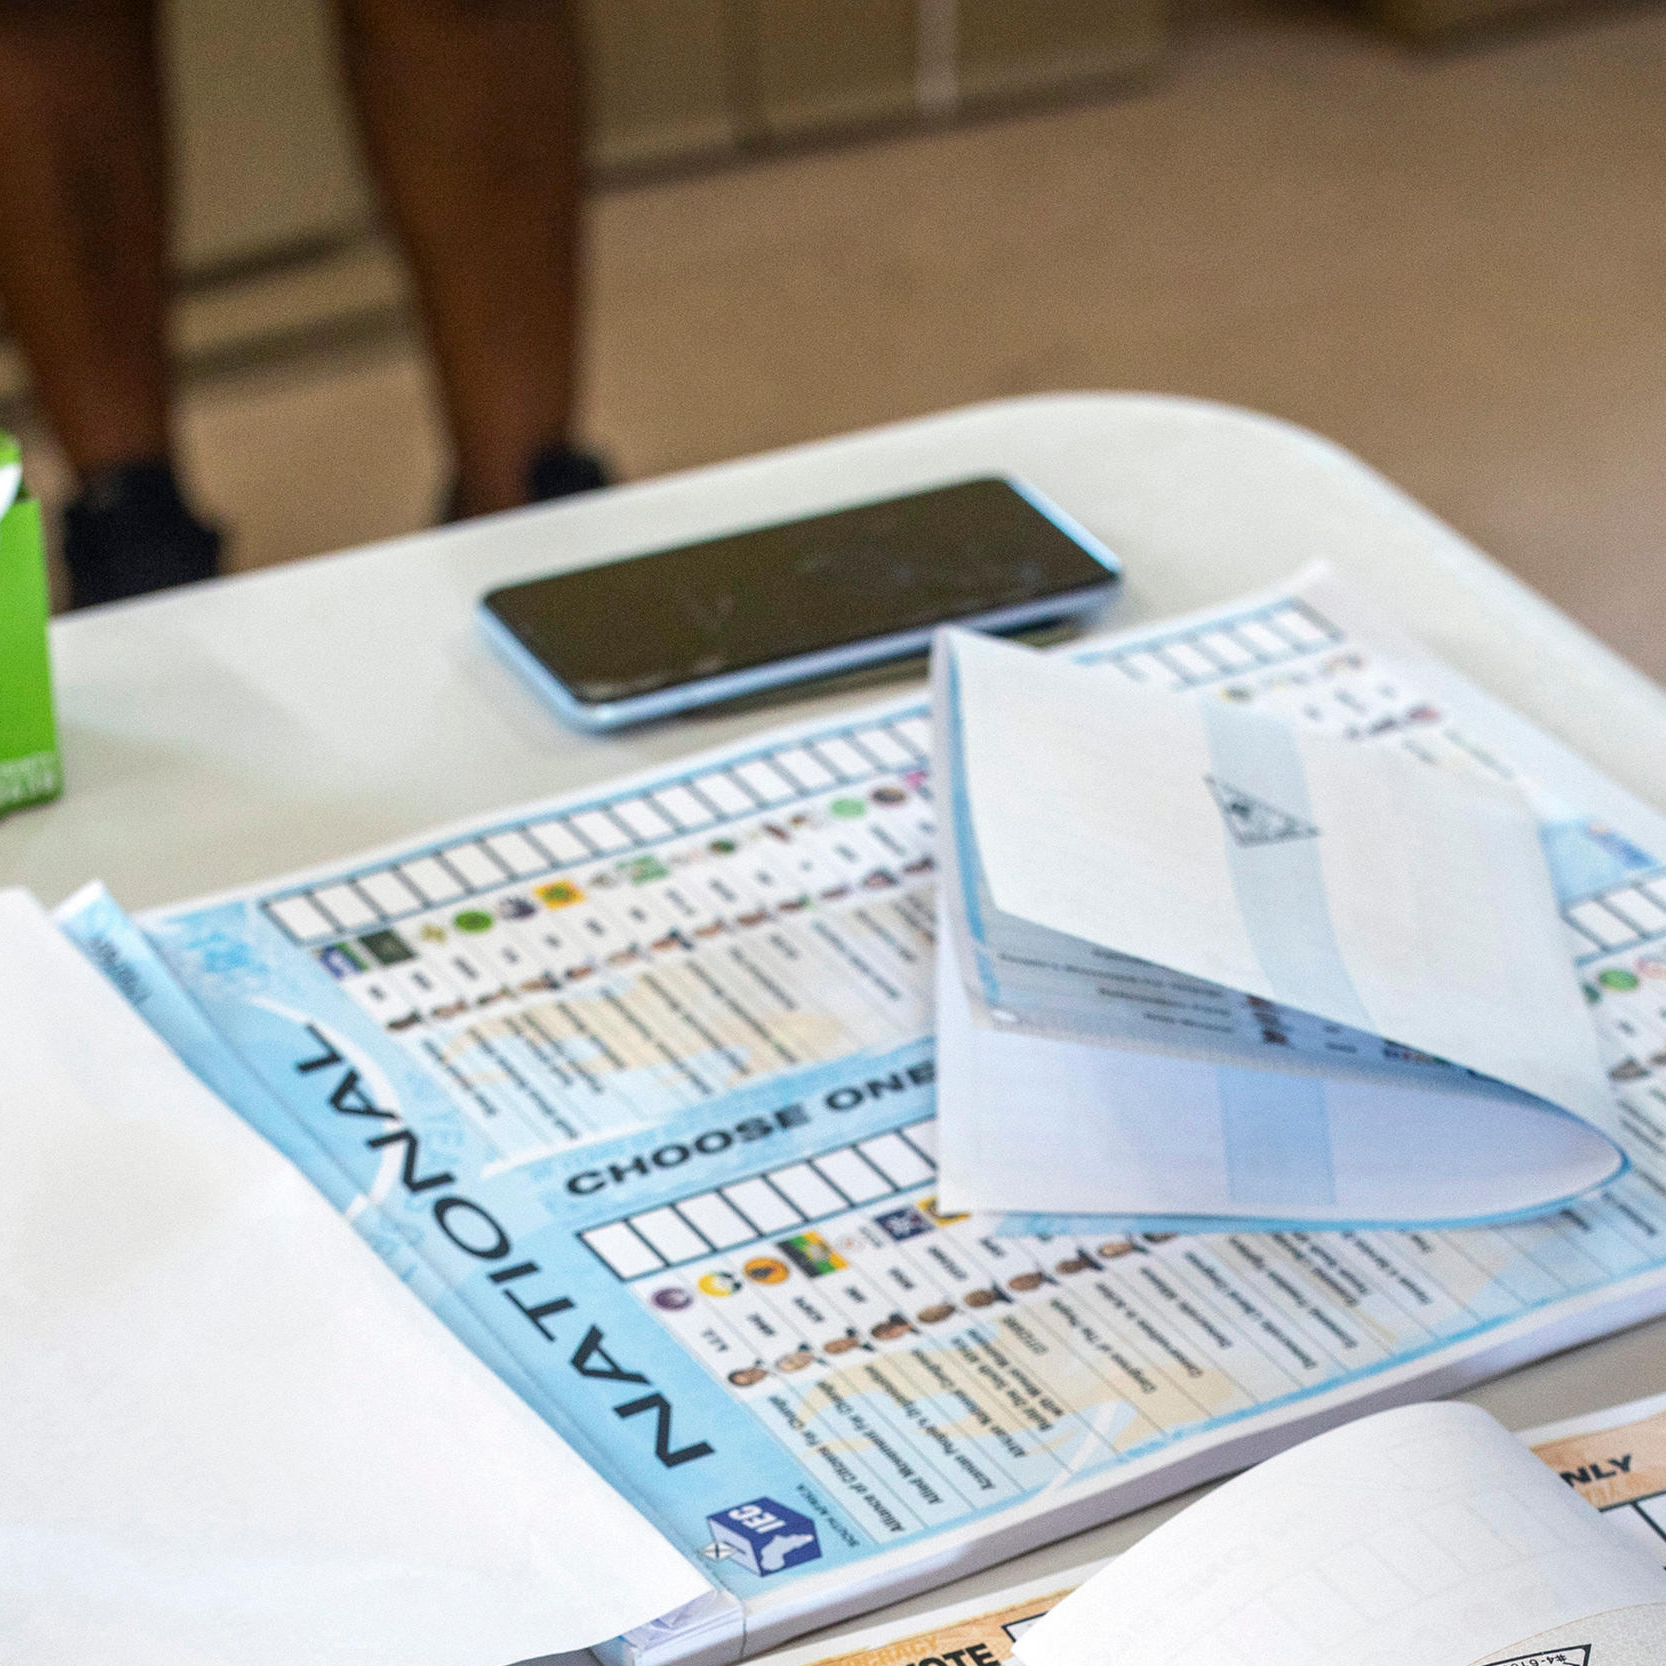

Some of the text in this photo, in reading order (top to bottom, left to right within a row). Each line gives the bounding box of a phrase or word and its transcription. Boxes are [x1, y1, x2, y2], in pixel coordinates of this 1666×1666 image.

[566, 1061, 937, 1198] CHOOSE ONE
[295, 1022, 716, 1469] NATIONAL
[1560, 1454, 1631, 1488] NLY
[729, 1505, 786, 1533] IEC
